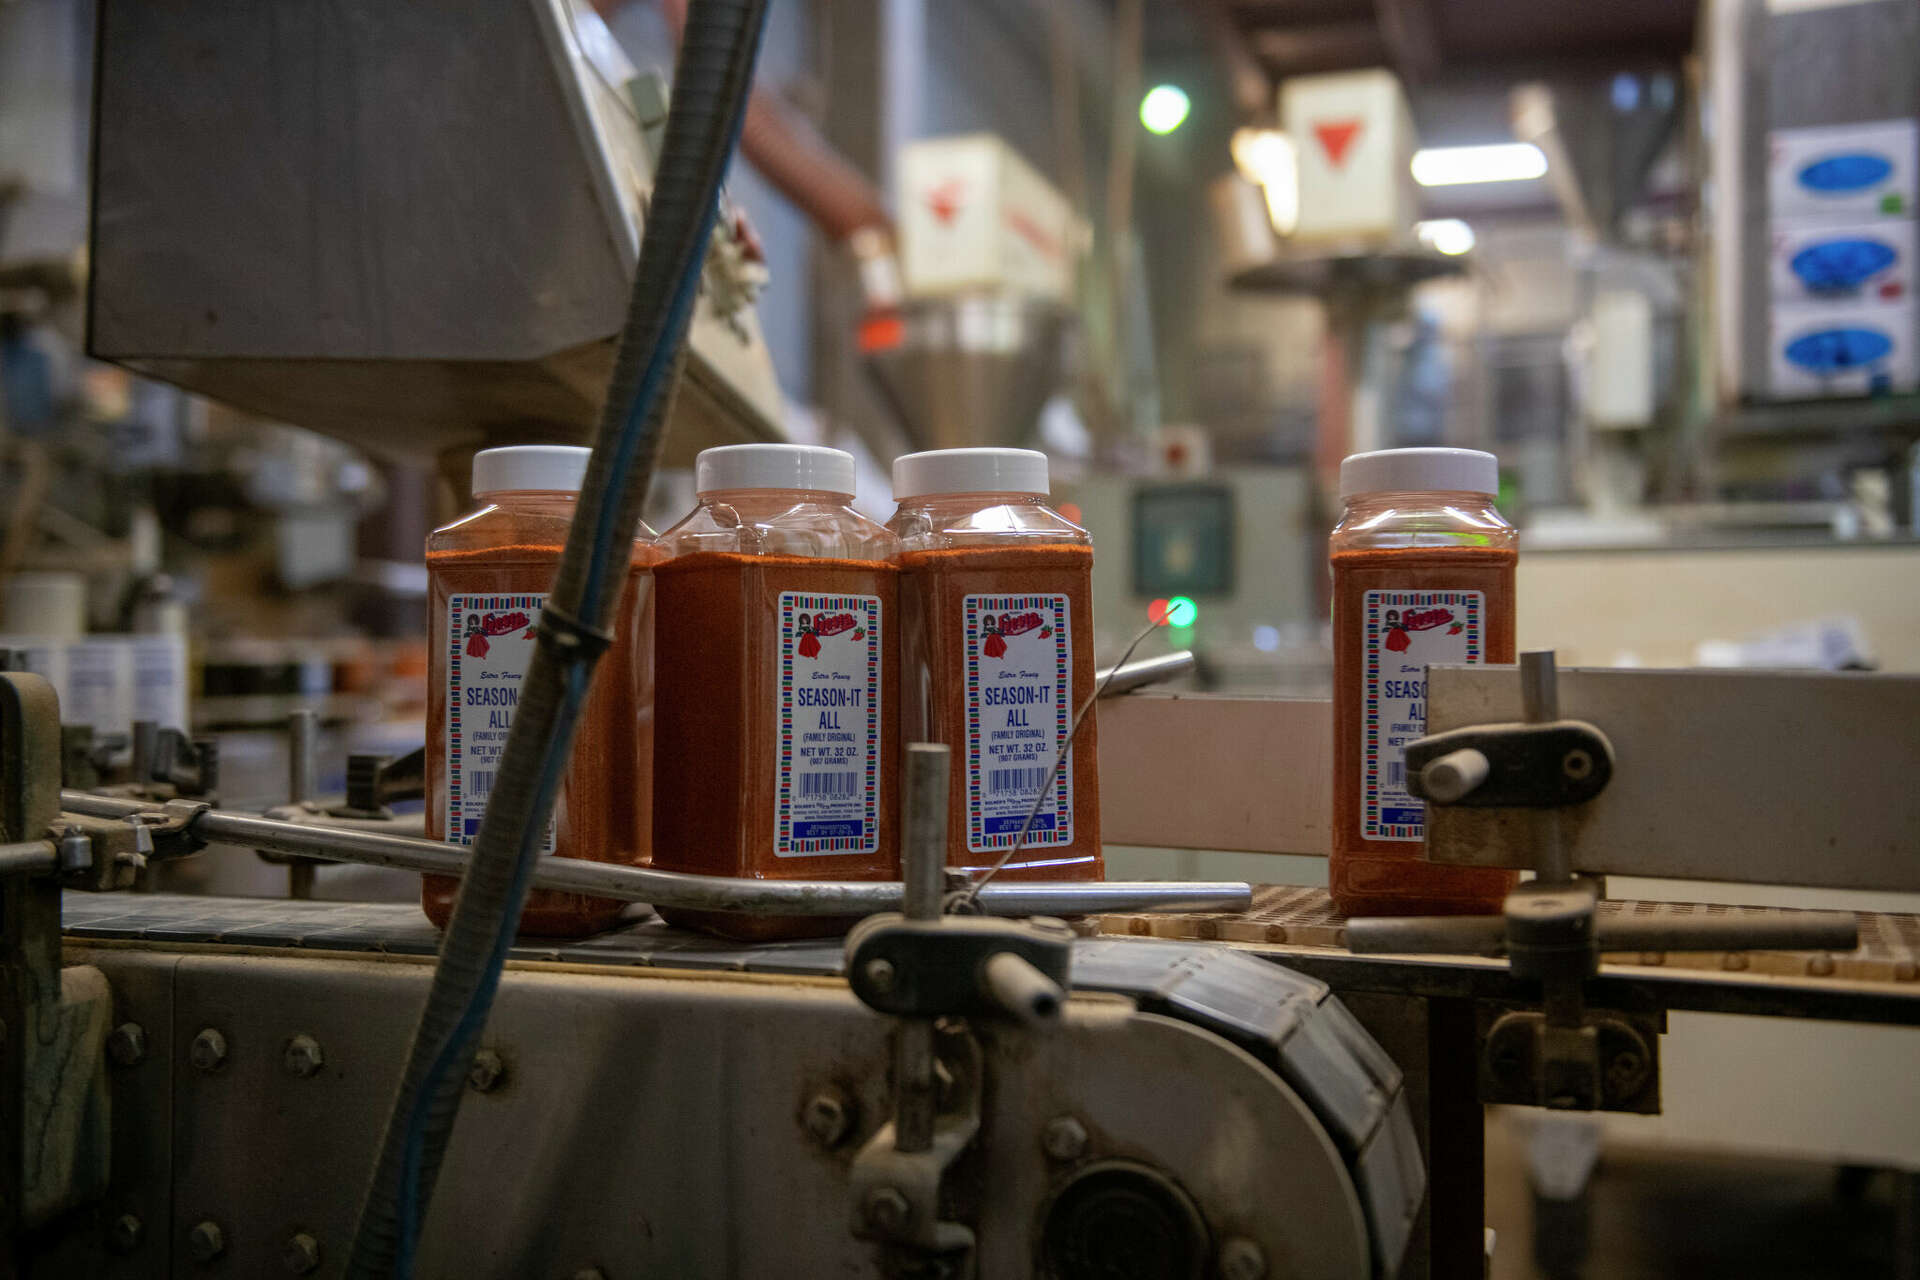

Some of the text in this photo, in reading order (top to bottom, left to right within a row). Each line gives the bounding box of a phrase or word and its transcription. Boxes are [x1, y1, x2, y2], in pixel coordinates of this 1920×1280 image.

[466, 687, 519, 706] SEASON
[798, 688, 862, 707] SEASON-IT
[985, 685, 1050, 706] SEASON-IT
[1385, 680, 1428, 699] SEASO
[489, 711, 512, 729] ALL
[818, 711, 841, 729] ALL
[1007, 708, 1029, 727] ALL
[1408, 703, 1426, 721] AL
[803, 732, 856, 743] (FAMILY ORIGINAL)
[991, 728, 1045, 741] (FAMILY ORIGINAL)
[1387, 737, 1405, 746] NET
[470, 746, 487, 755] NET
[800, 747, 859, 757] NET WT. 32 OZ.
[989, 742, 1049, 754] NET WT. 32 OZ.
